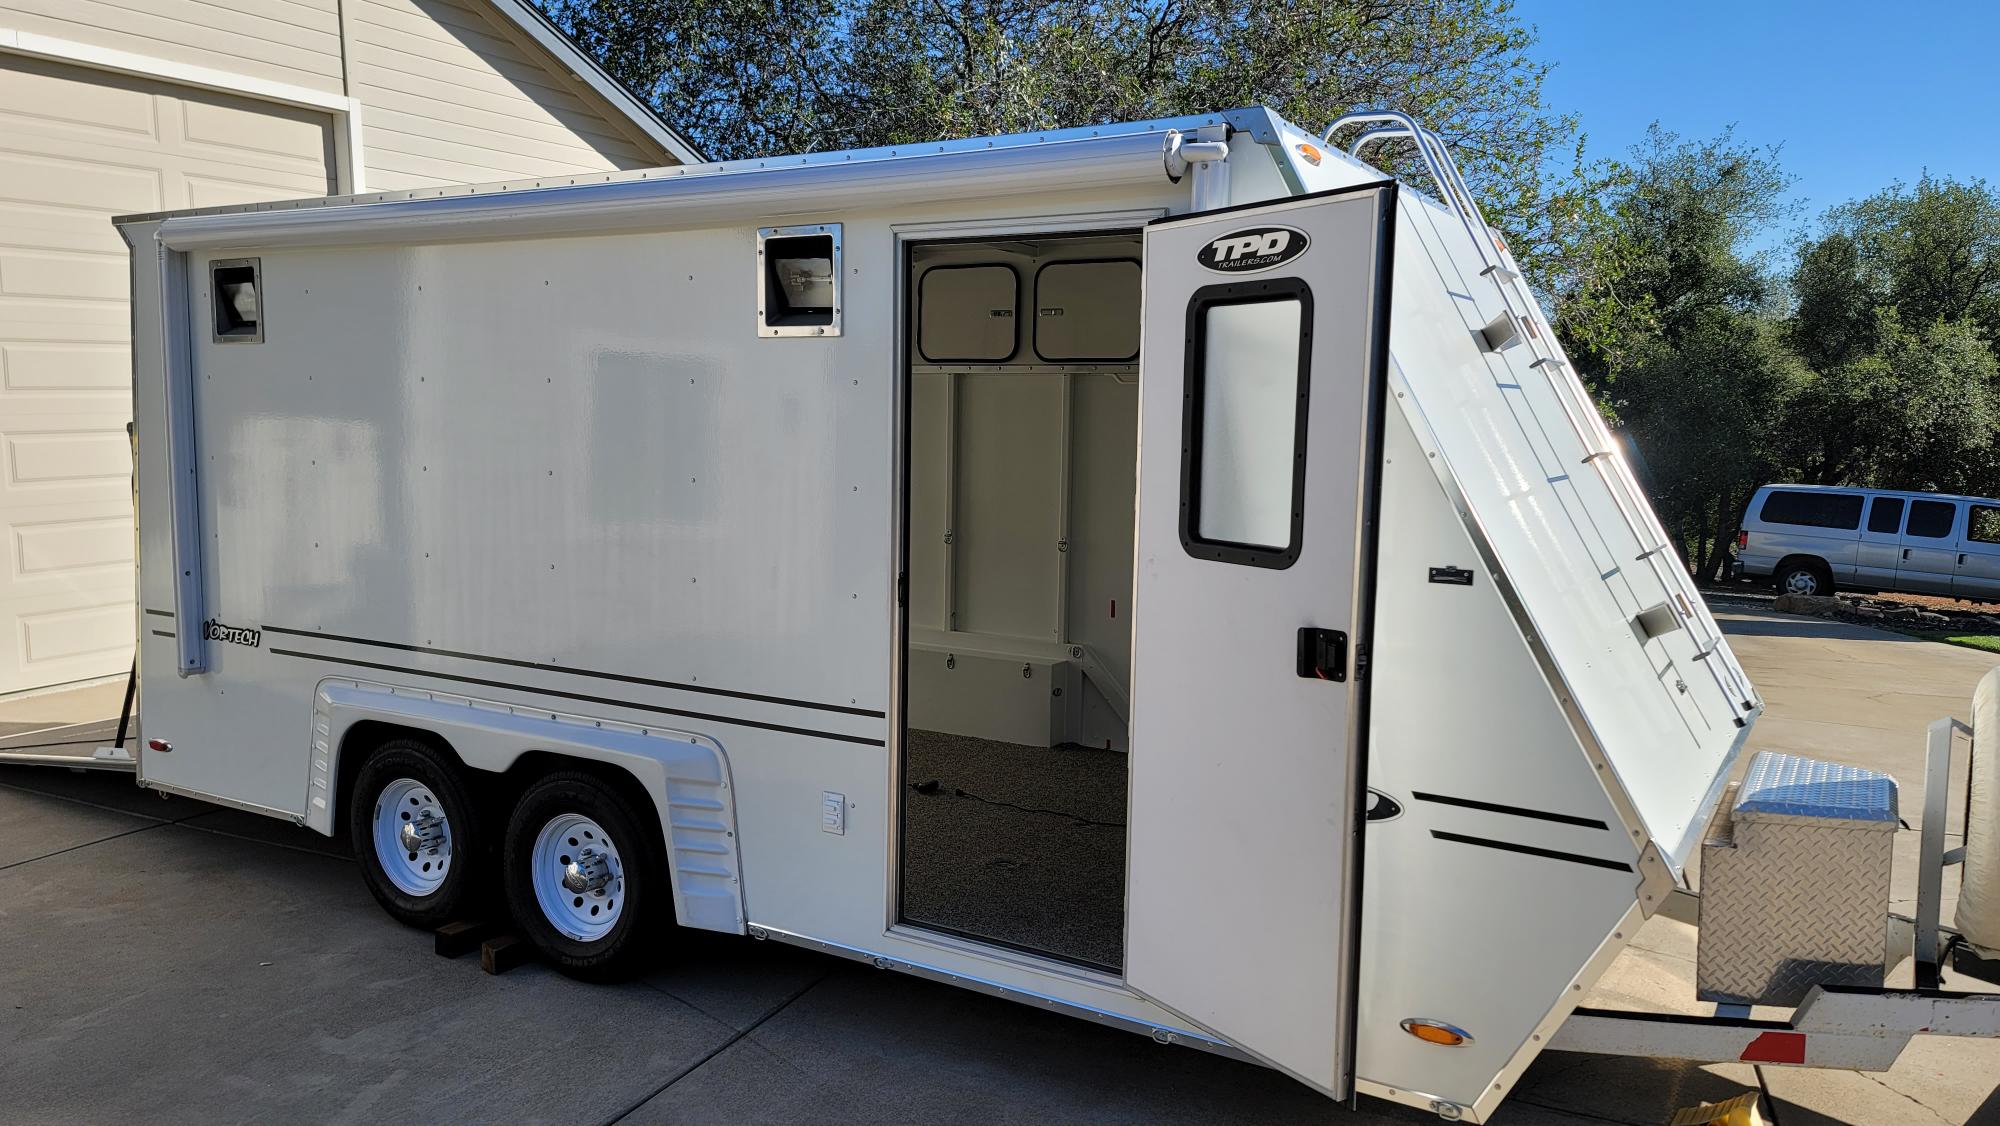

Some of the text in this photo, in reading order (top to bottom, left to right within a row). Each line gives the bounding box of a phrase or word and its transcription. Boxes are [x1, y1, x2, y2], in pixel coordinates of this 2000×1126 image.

[1211, 230, 1291, 262] TPD
[1218, 255, 1282, 269] TRAILERS.COM
[203, 618, 261, 648] VORTECH
